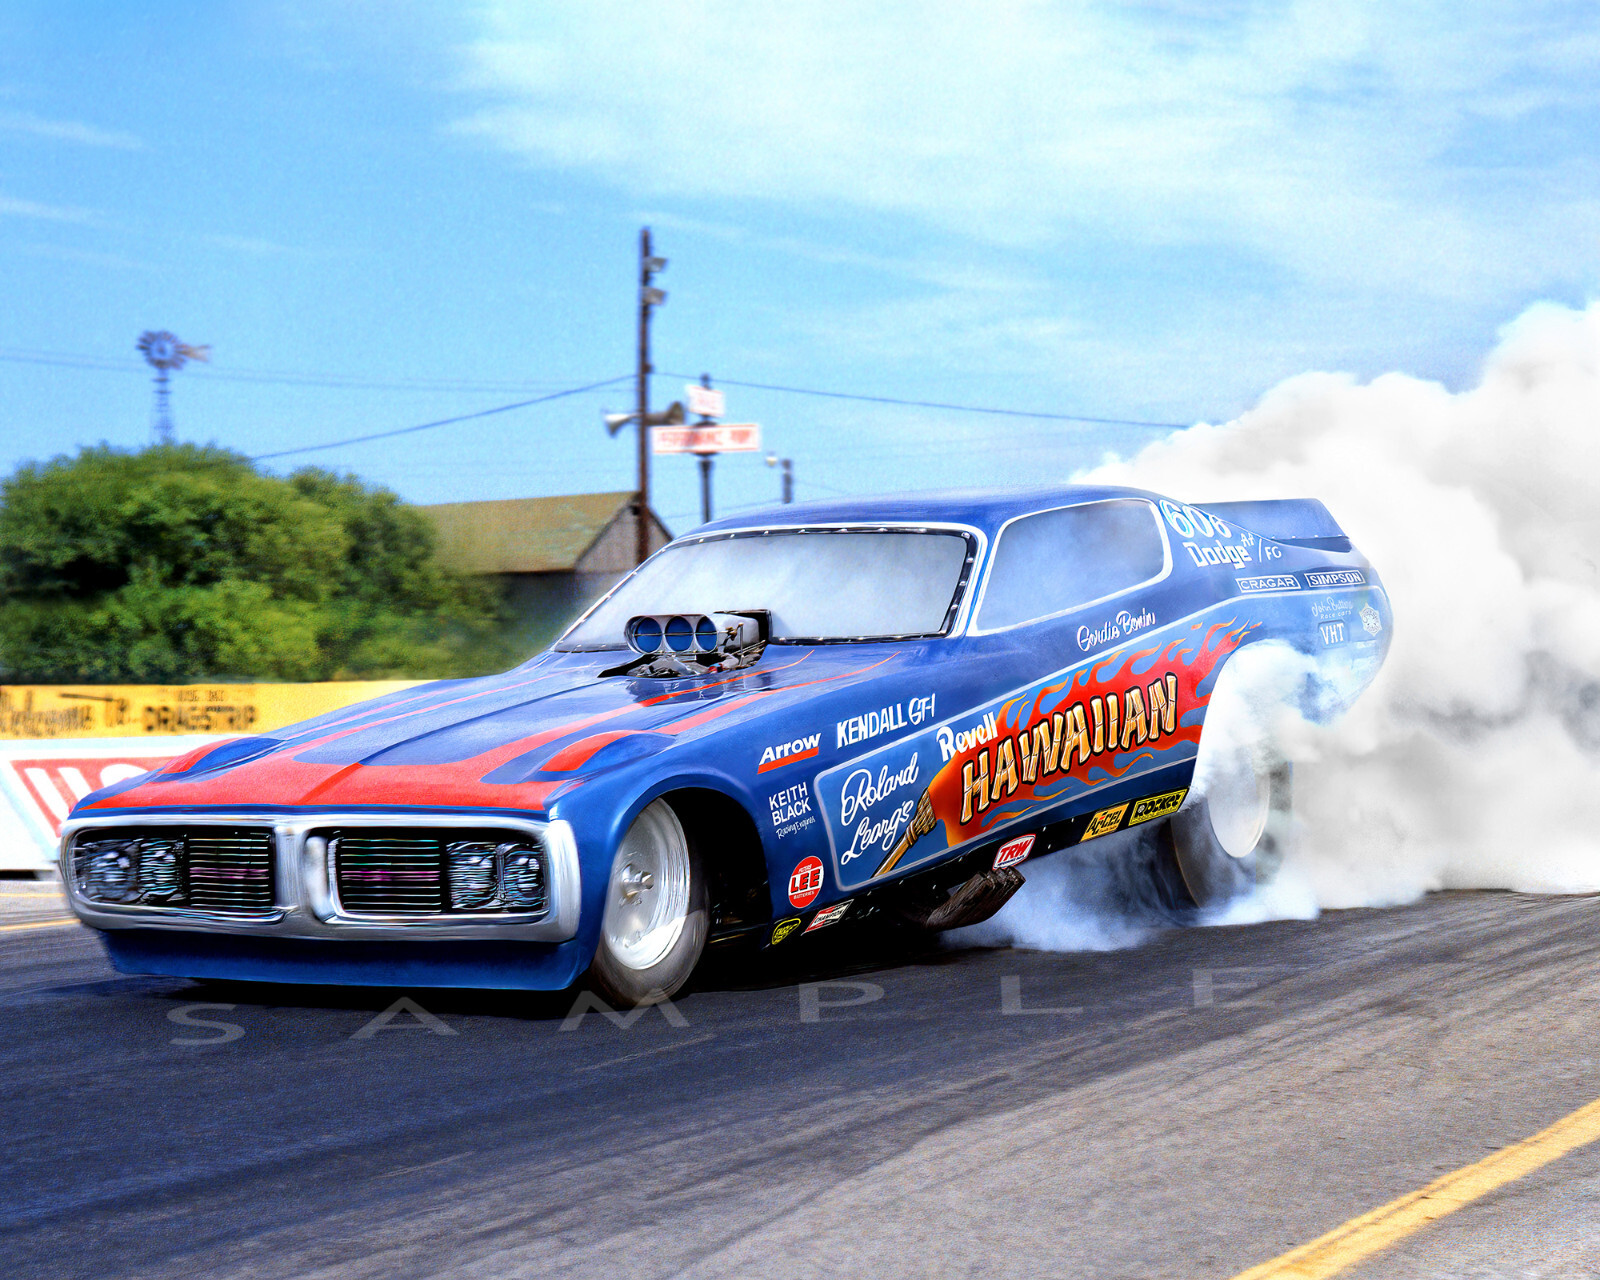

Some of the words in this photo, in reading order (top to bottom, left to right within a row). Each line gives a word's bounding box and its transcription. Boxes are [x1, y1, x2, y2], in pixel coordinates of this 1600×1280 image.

[1182, 539, 1252, 569] Dodge
[1240, 577, 1296, 591] CRAGAR
[1311, 572, 1362, 586] SIMPSON
[1320, 622, 1345, 645] VHT
[836, 703, 908, 750] KENDALL
[936, 711, 999, 763] Revell
[759, 732, 822, 766] Arrow
[959, 672, 1178, 825] HAWAIIAN
[768, 781, 808, 811] KEITH
[841, 752, 919, 827] Roland
[772, 797, 812, 827] BLACK
[996, 837, 1034, 864] TRW
[790, 868, 820, 893] LEE
